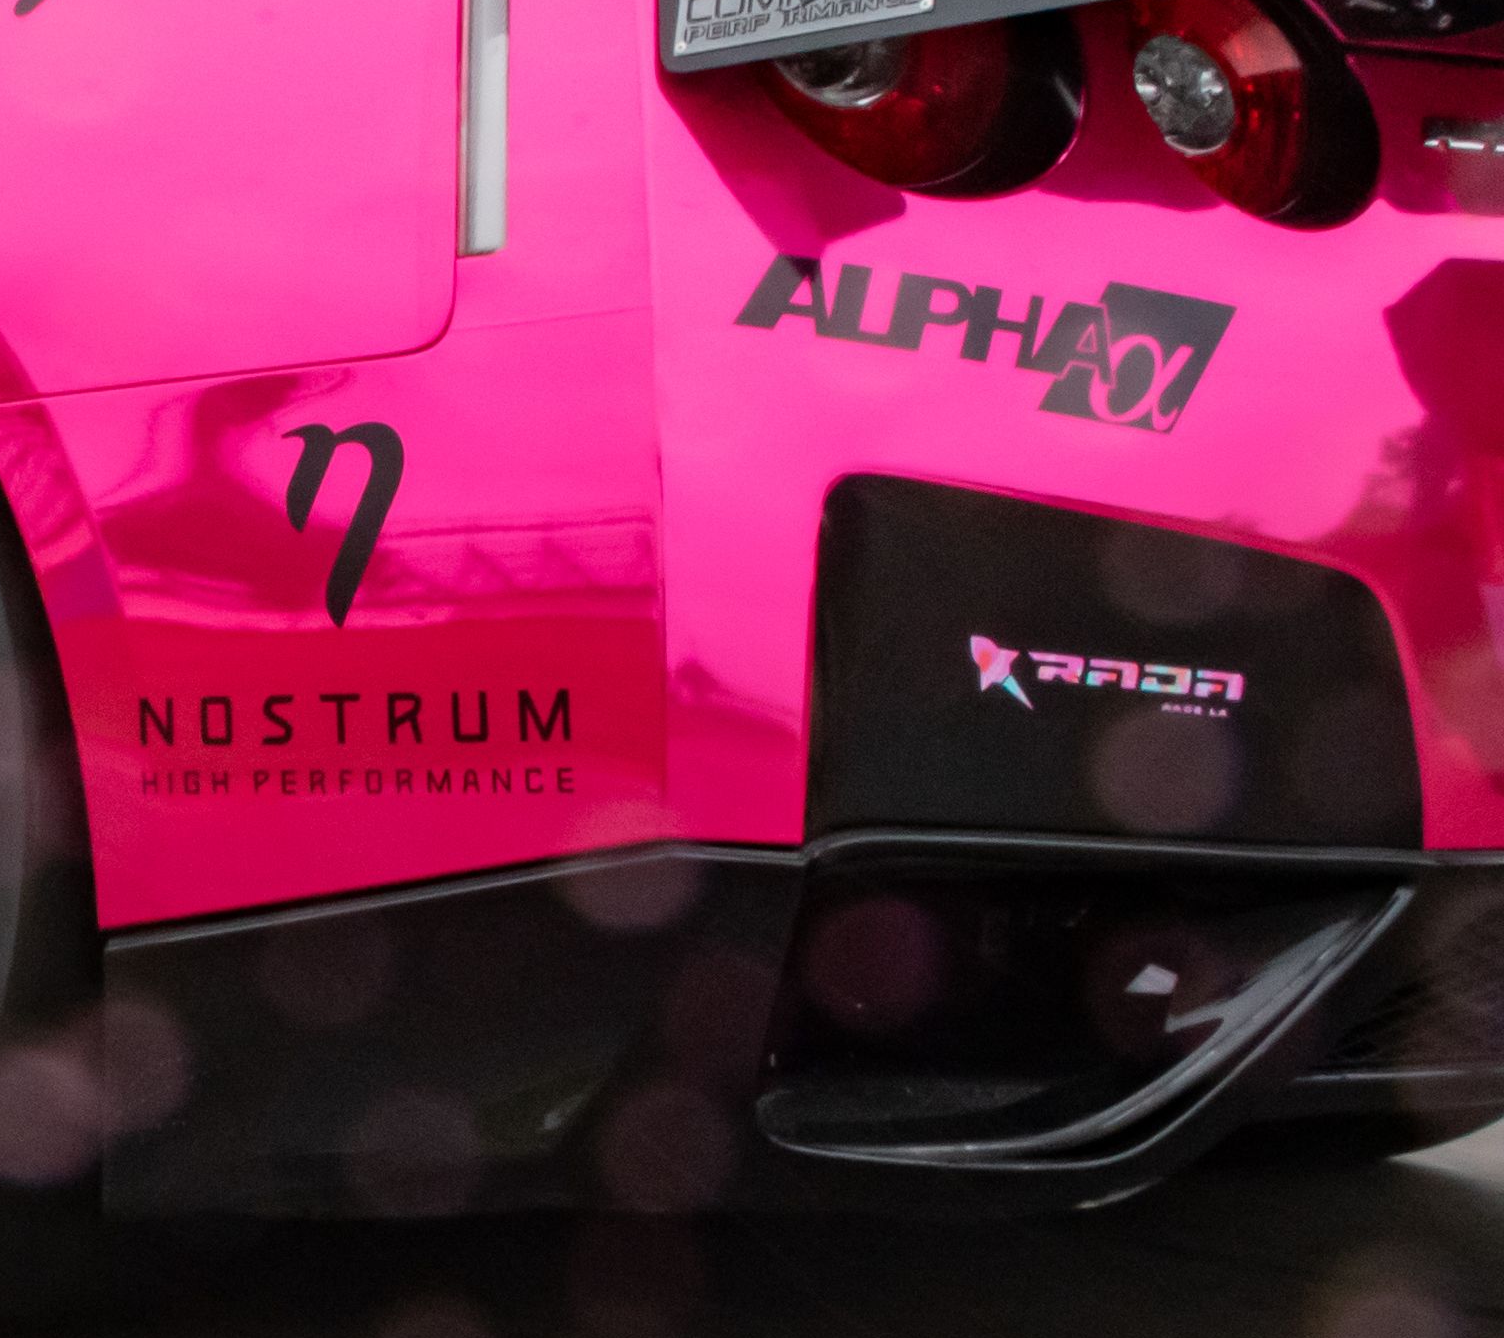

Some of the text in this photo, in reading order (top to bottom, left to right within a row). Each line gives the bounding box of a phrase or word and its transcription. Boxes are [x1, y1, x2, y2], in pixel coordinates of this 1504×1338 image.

[138, 688, 572, 746] NOSTRUM
[141, 767, 576, 795] HIGH PERFORMANCE
